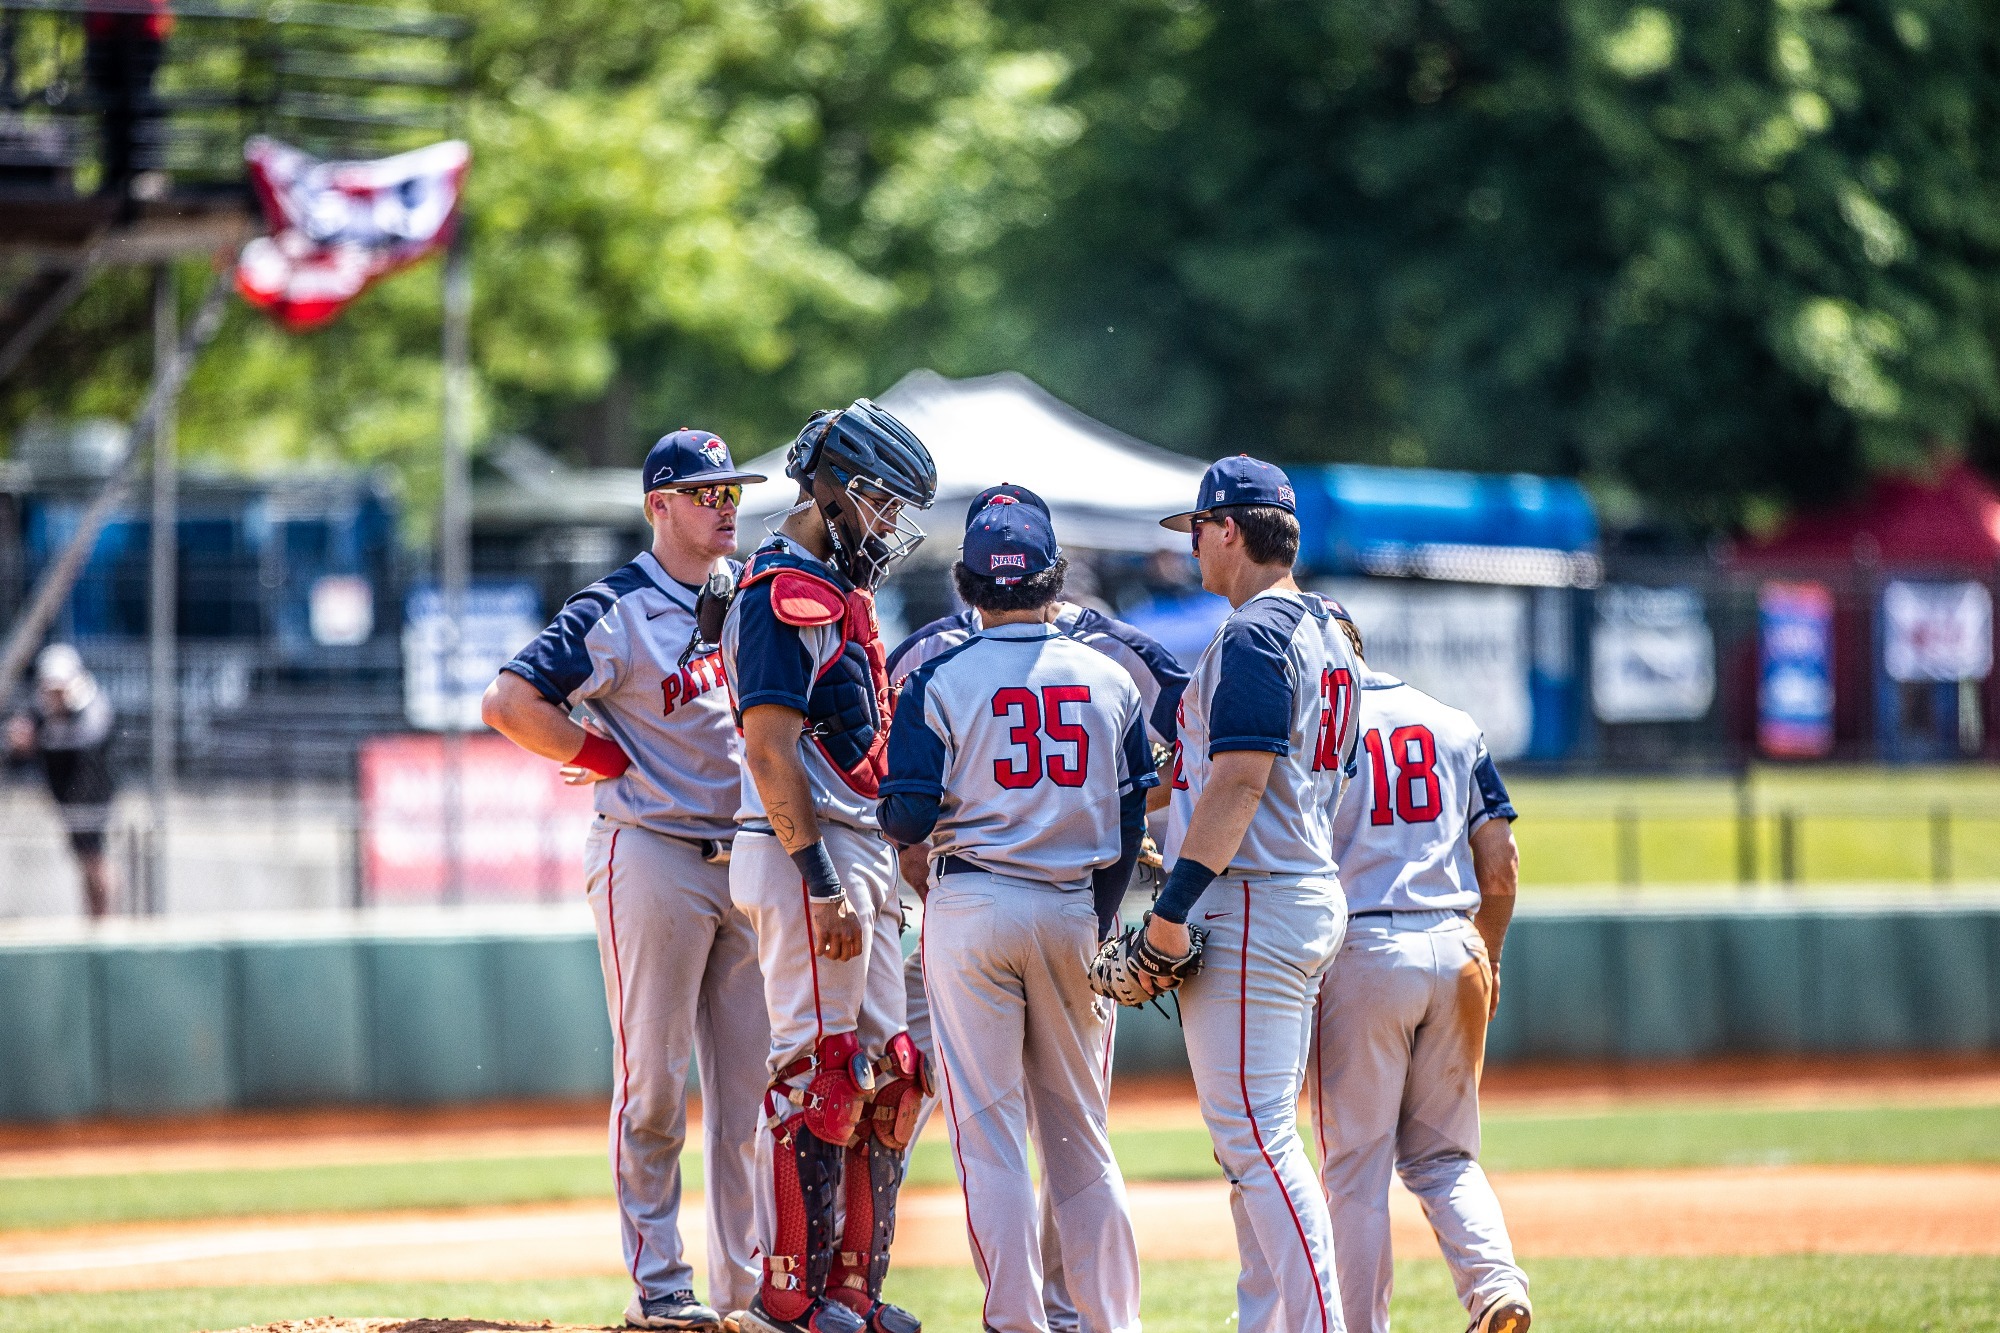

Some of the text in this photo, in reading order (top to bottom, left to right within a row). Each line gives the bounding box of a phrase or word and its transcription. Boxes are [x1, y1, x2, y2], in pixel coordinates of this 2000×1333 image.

[992, 554, 1024, 568] NAIA
[661, 652, 726, 717] PATR
[990, 684, 1092, 791] 35
[1362, 723, 1443, 826] 18
